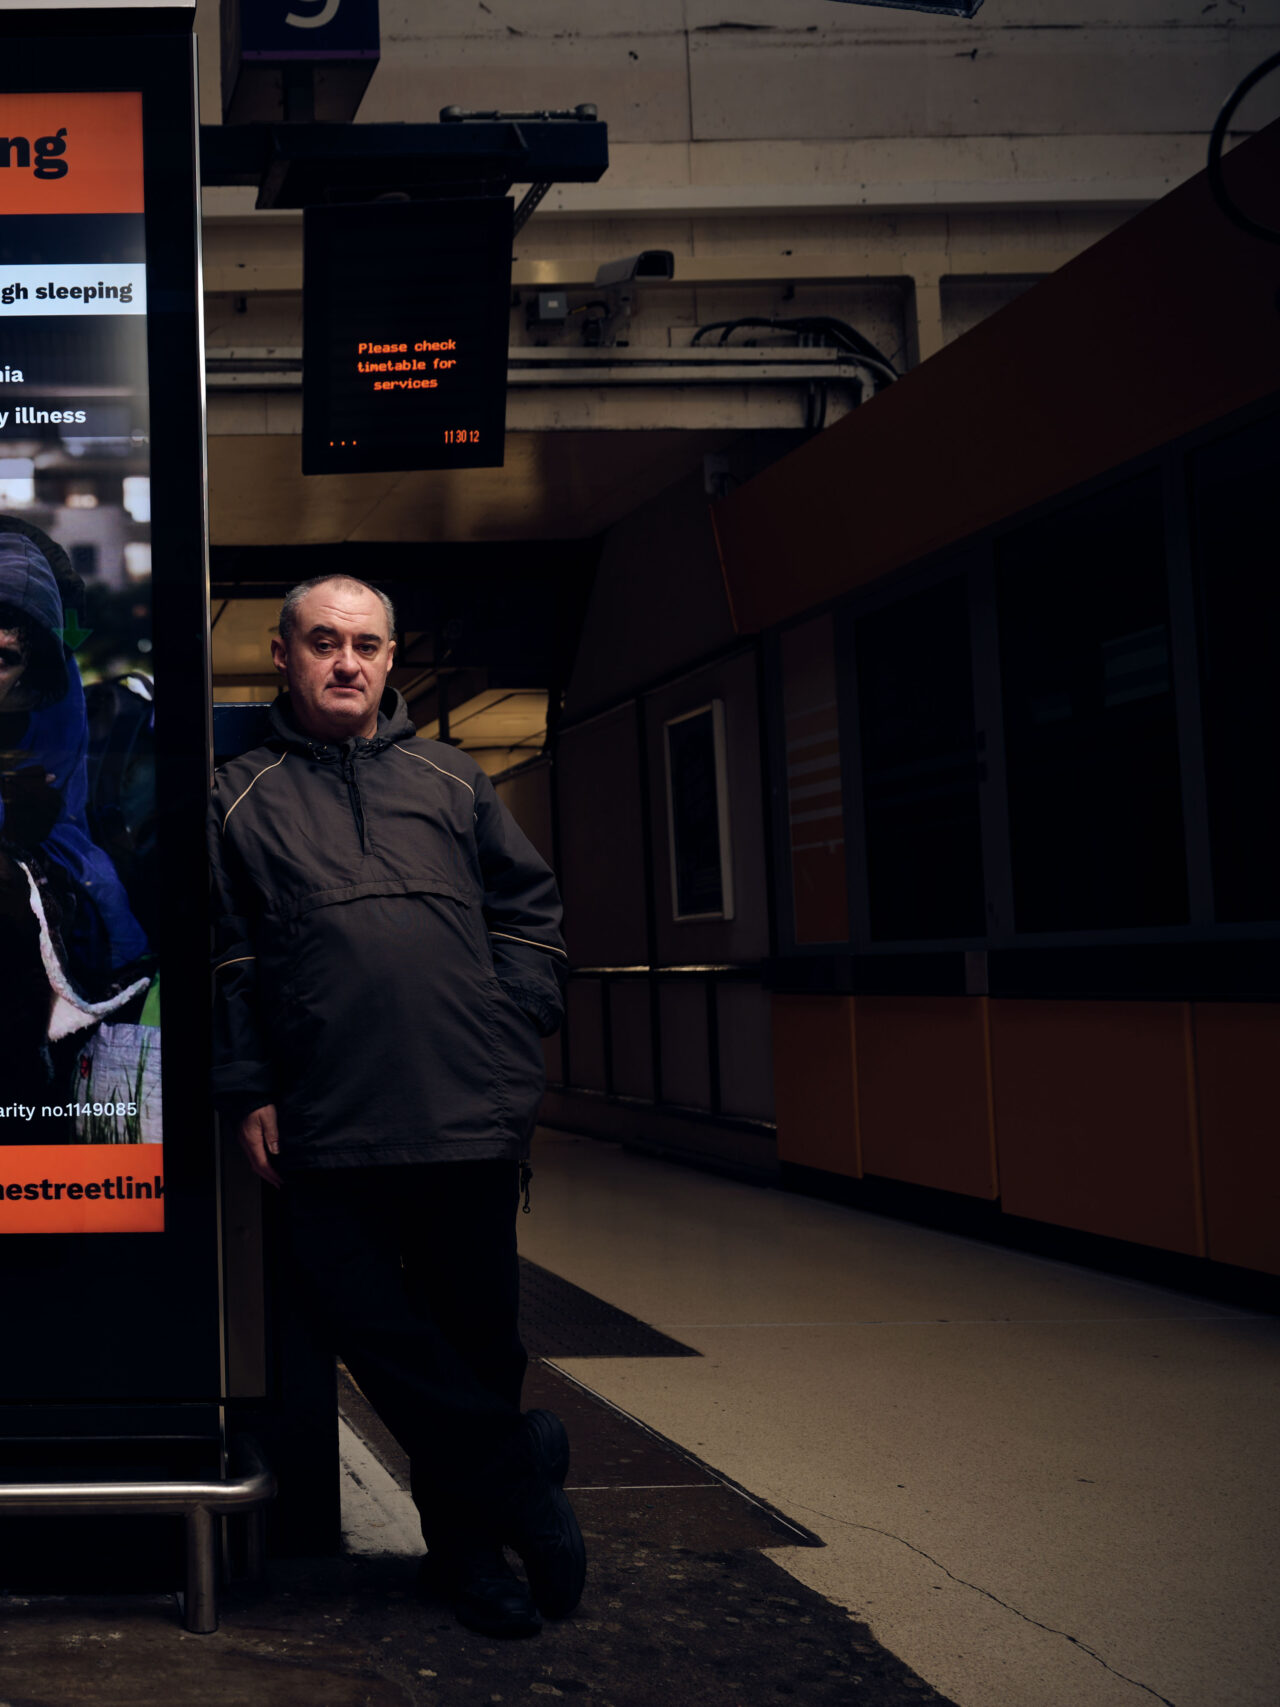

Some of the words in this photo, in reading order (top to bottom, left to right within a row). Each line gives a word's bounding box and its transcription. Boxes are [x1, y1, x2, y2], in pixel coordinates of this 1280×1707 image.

[35, 281, 133, 304] sleeping
[358, 342, 408, 354] Please
[413, 338, 457, 352] check
[357, 359, 427, 373] timetable
[432, 357, 457, 370] for
[373, 377, 439, 391] services
[15, 406, 88, 424] illness
[41, 1101, 138, 1118] no.1149085
